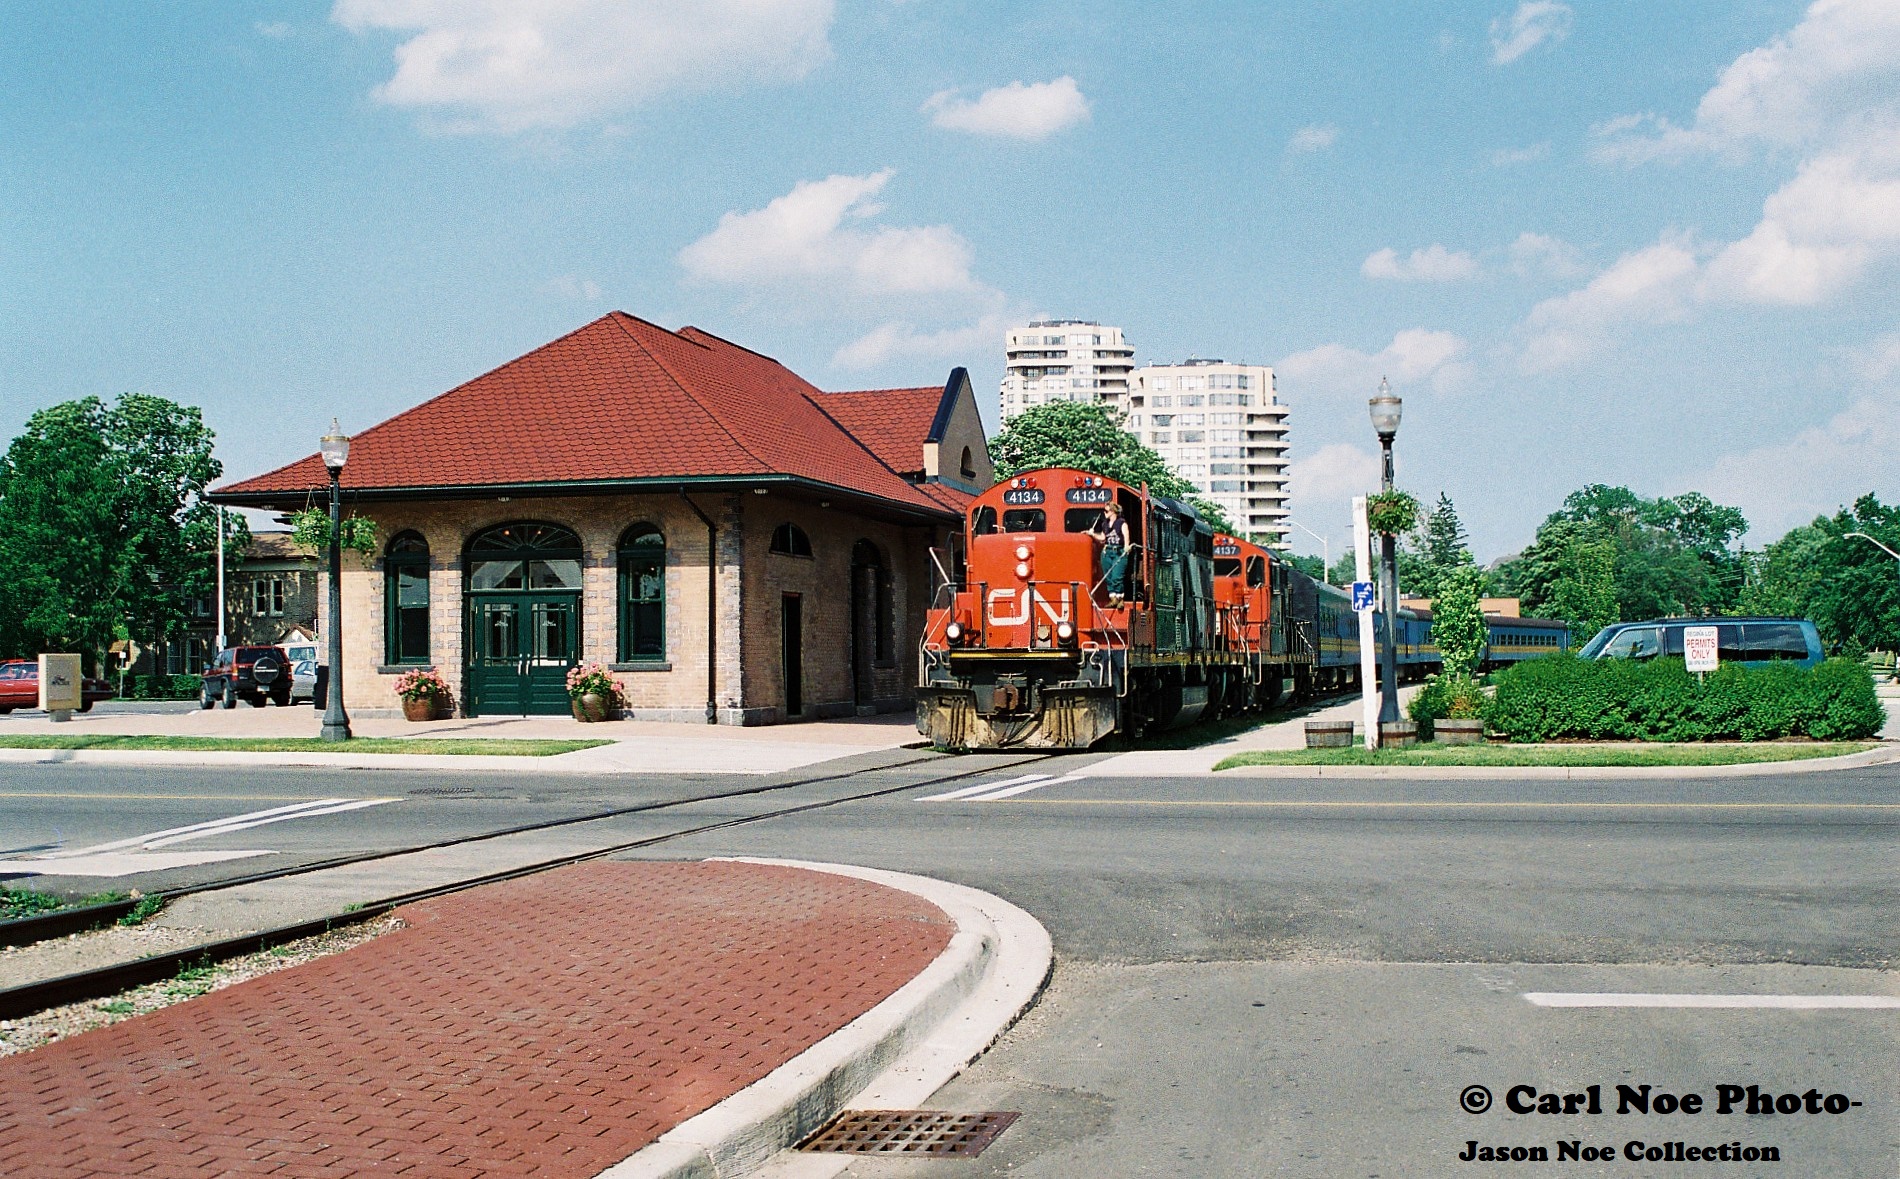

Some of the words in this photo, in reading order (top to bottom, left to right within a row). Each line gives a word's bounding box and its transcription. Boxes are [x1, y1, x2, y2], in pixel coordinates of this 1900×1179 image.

[1009, 490, 1040, 504] 4134
[1072, 489, 1106, 503] 4134
[1214, 546, 1237, 555] 4137
[987, 588, 1070, 627] CN
[1686, 638, 1716, 649] PERMITS
[1691, 649, 1710, 659] ONLY
